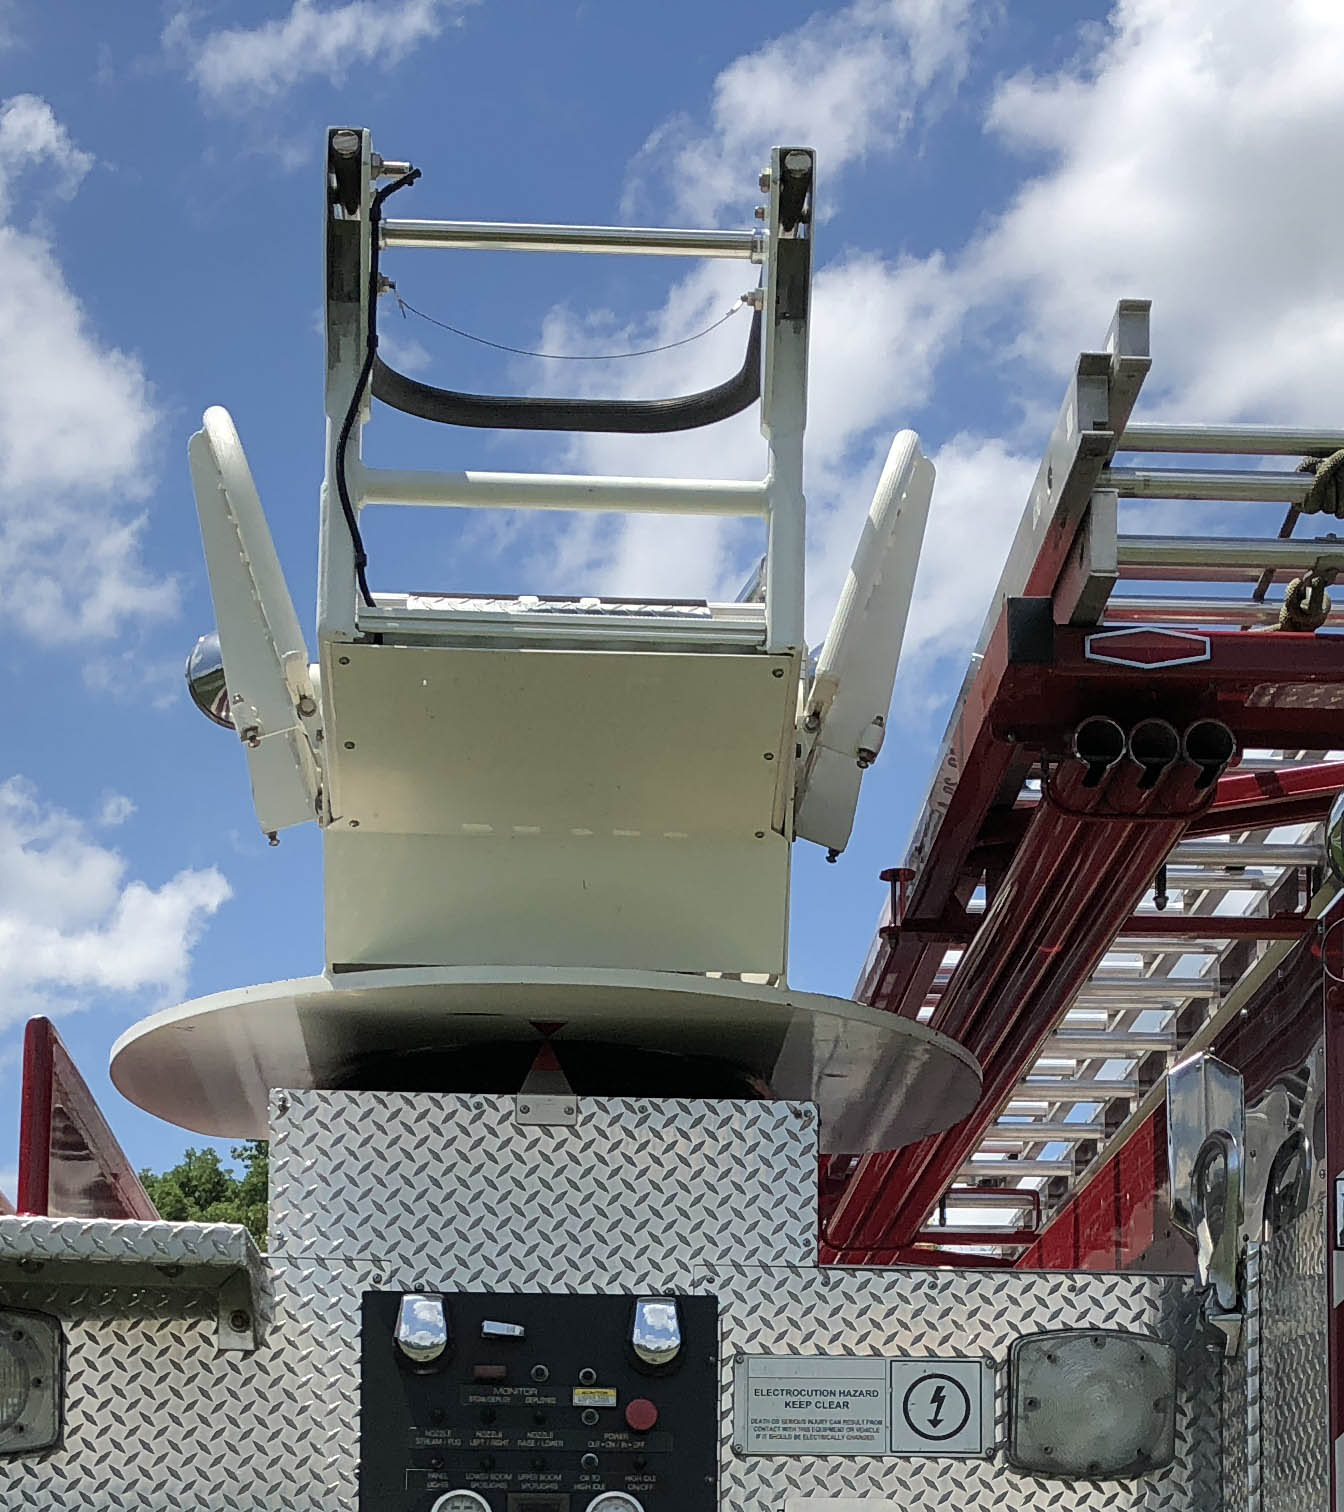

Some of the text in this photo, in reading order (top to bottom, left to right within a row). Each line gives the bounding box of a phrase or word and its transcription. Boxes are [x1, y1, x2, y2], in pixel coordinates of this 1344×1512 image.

[492, 1387, 538, 1395] MONITOR
[754, 1388, 879, 1398] ELECTROCUTION HAZARD
[784, 1400, 850, 1410] KEEP CLEAR
